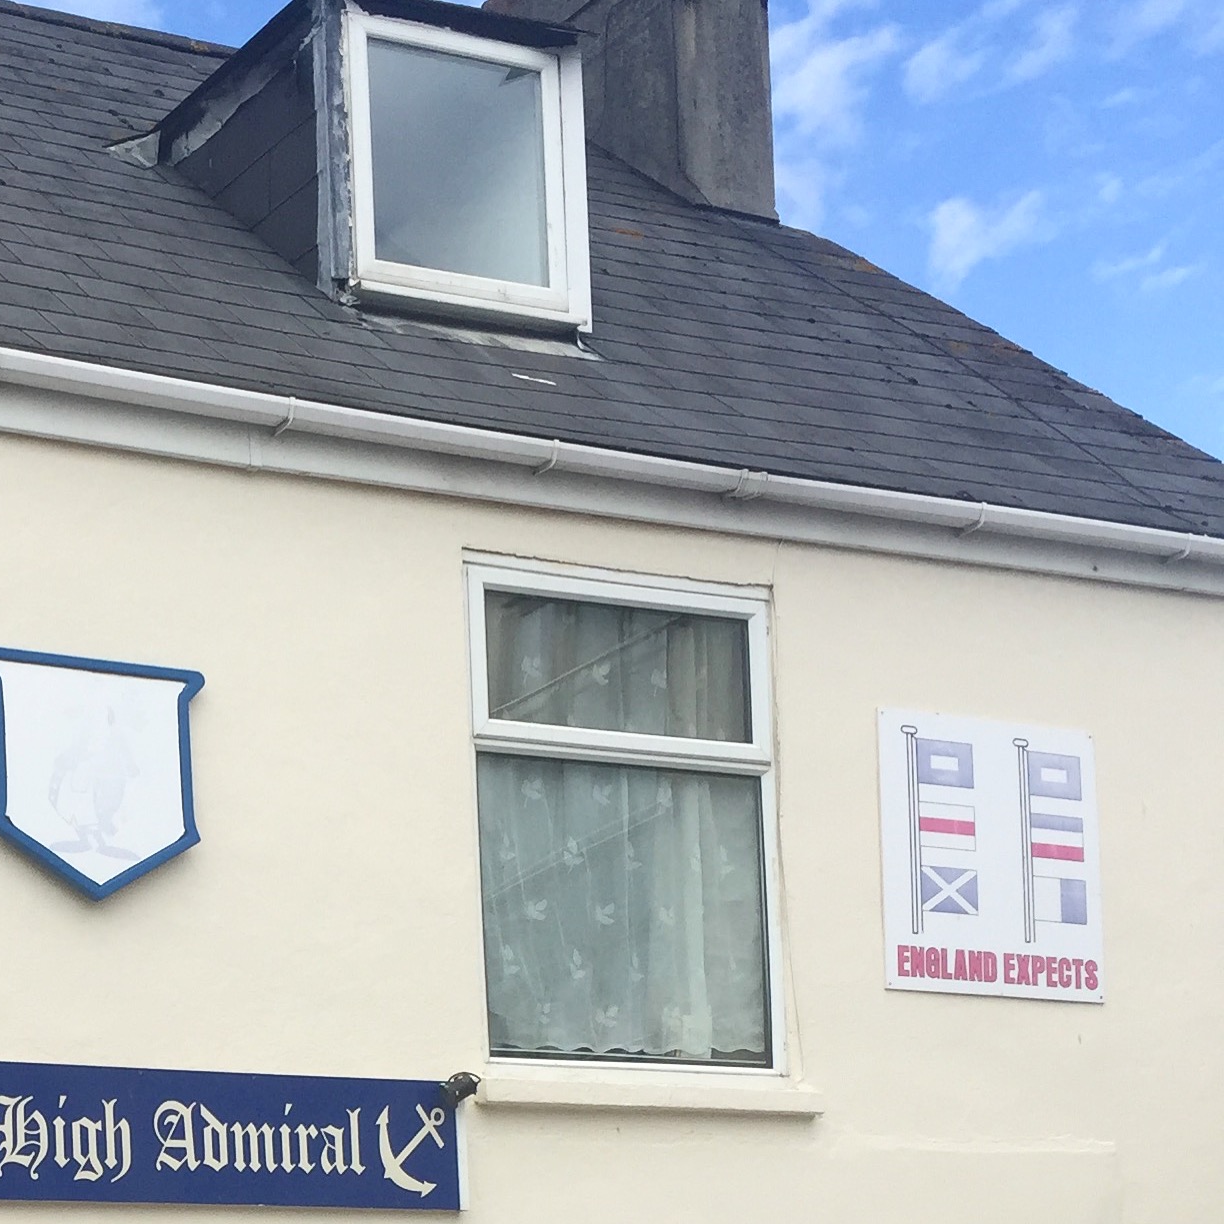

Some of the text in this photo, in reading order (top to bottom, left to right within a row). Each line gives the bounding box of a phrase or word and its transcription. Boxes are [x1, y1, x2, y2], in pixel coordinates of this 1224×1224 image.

[897, 944, 1099, 991] ENGLAND EXPECTS
[154, 1100, 366, 1177] Admiral
